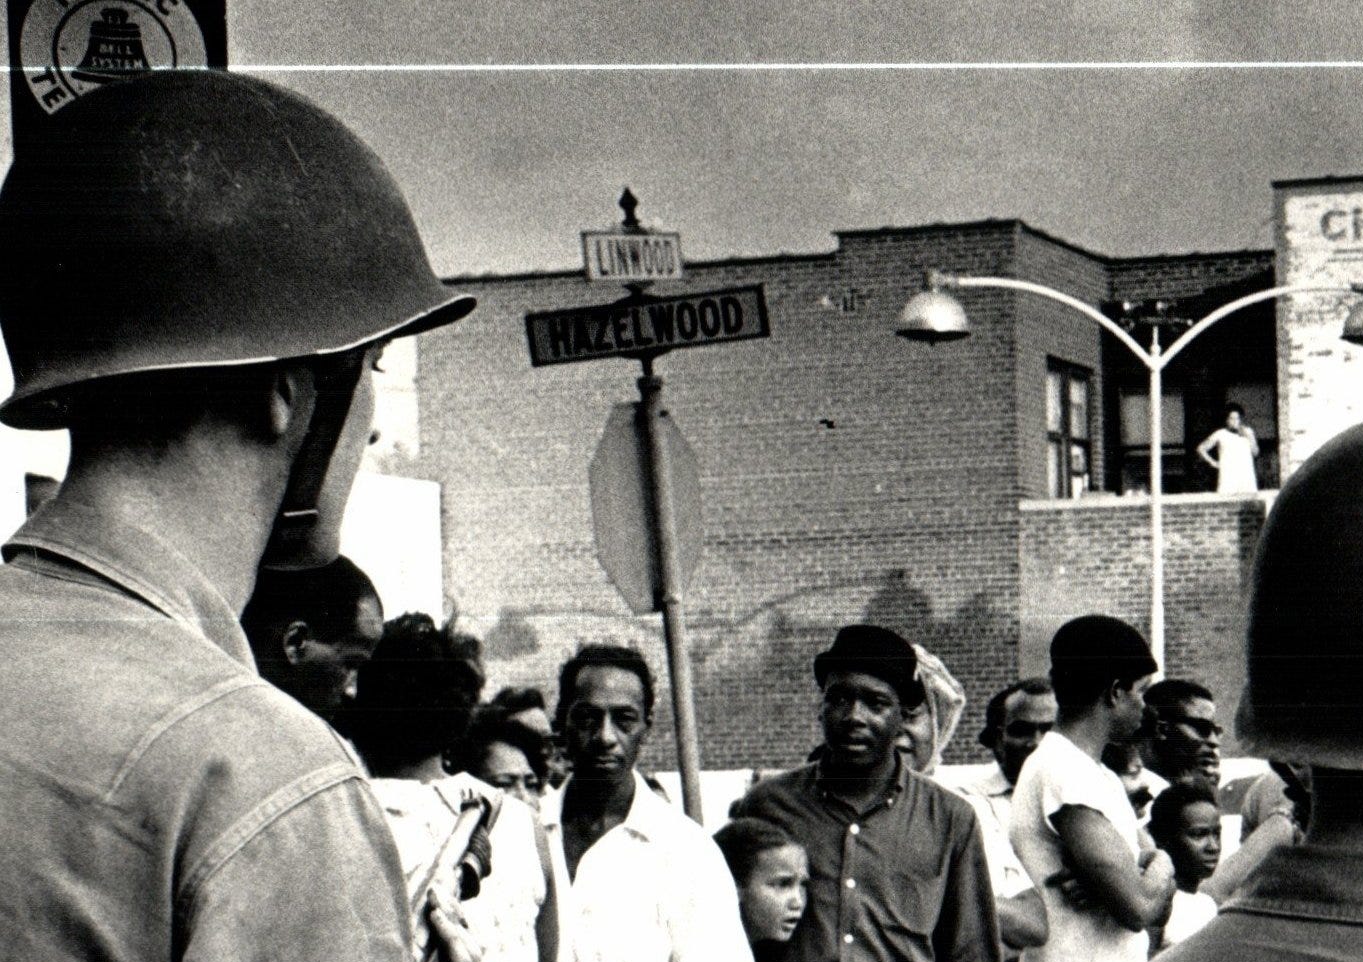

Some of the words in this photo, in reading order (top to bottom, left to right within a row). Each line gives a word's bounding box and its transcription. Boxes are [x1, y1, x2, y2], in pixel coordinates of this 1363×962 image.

[99, 43, 133, 55] BELL
[91, 56, 144, 70] SYSTEM
[596, 239, 676, 276] LINWOOD
[549, 296, 744, 357] HAZELWOOD
